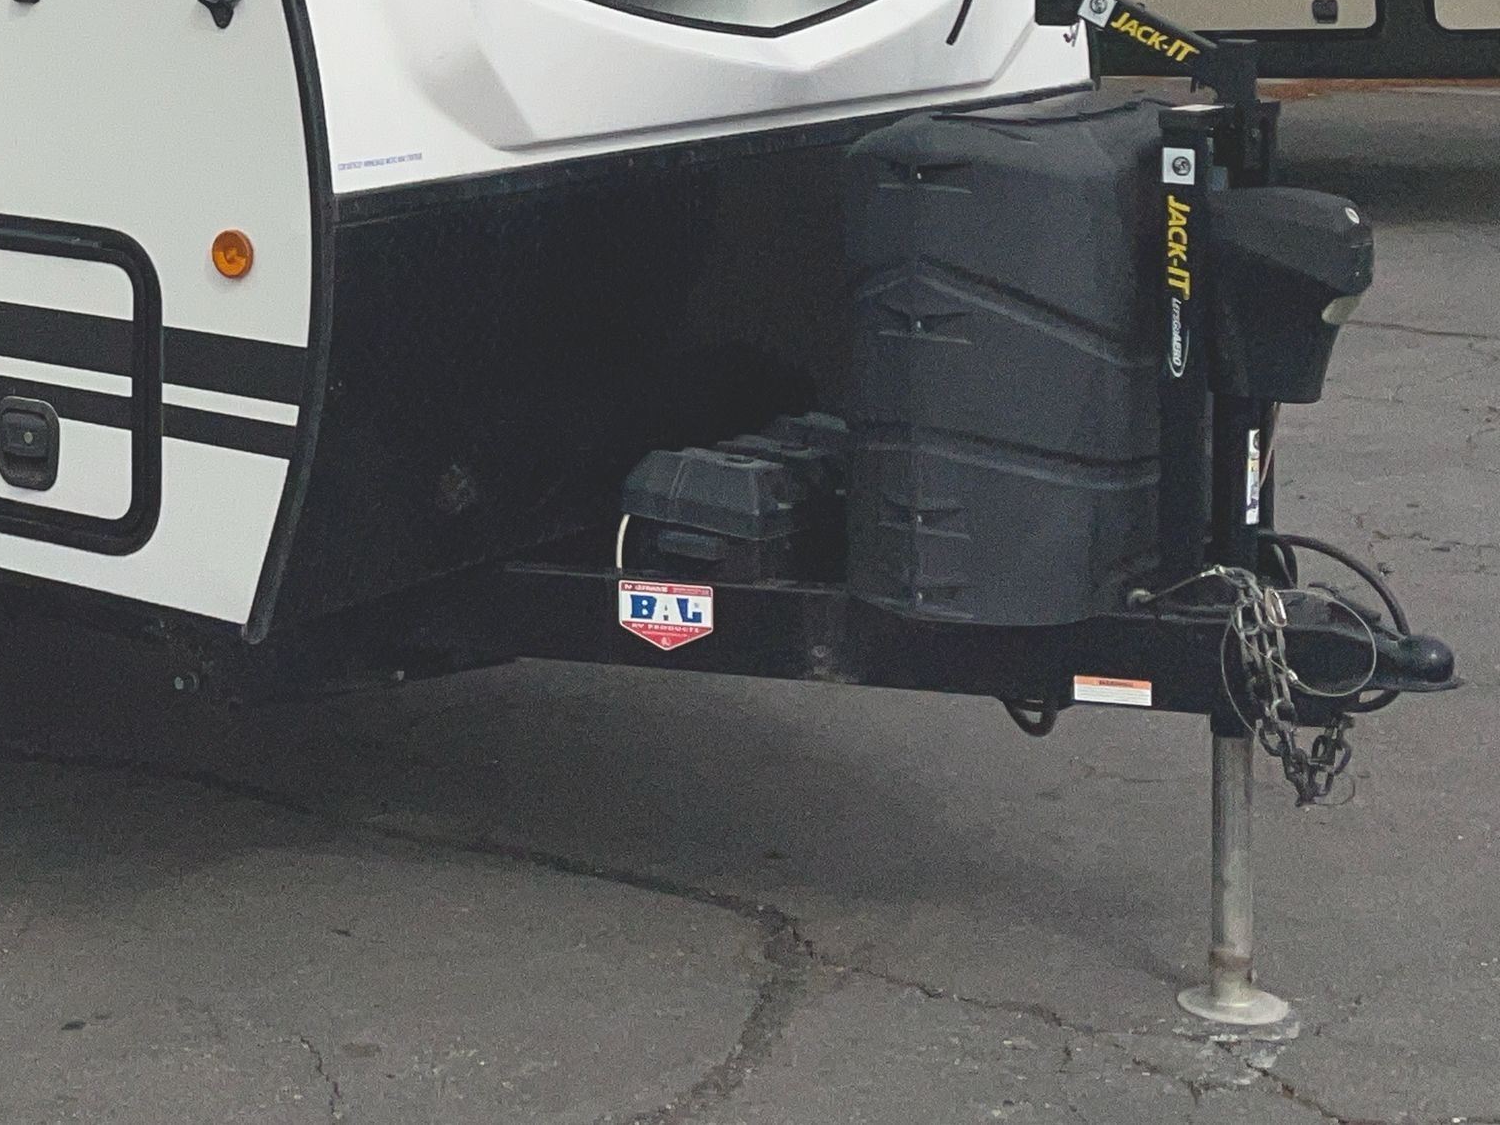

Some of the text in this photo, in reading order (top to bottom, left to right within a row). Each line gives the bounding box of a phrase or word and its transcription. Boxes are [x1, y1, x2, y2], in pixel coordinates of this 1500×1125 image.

[1110, 12, 1200, 62] JACK-IT
[1167, 195, 1191, 301] JACK-IT
[629, 594, 702, 624] BAL
